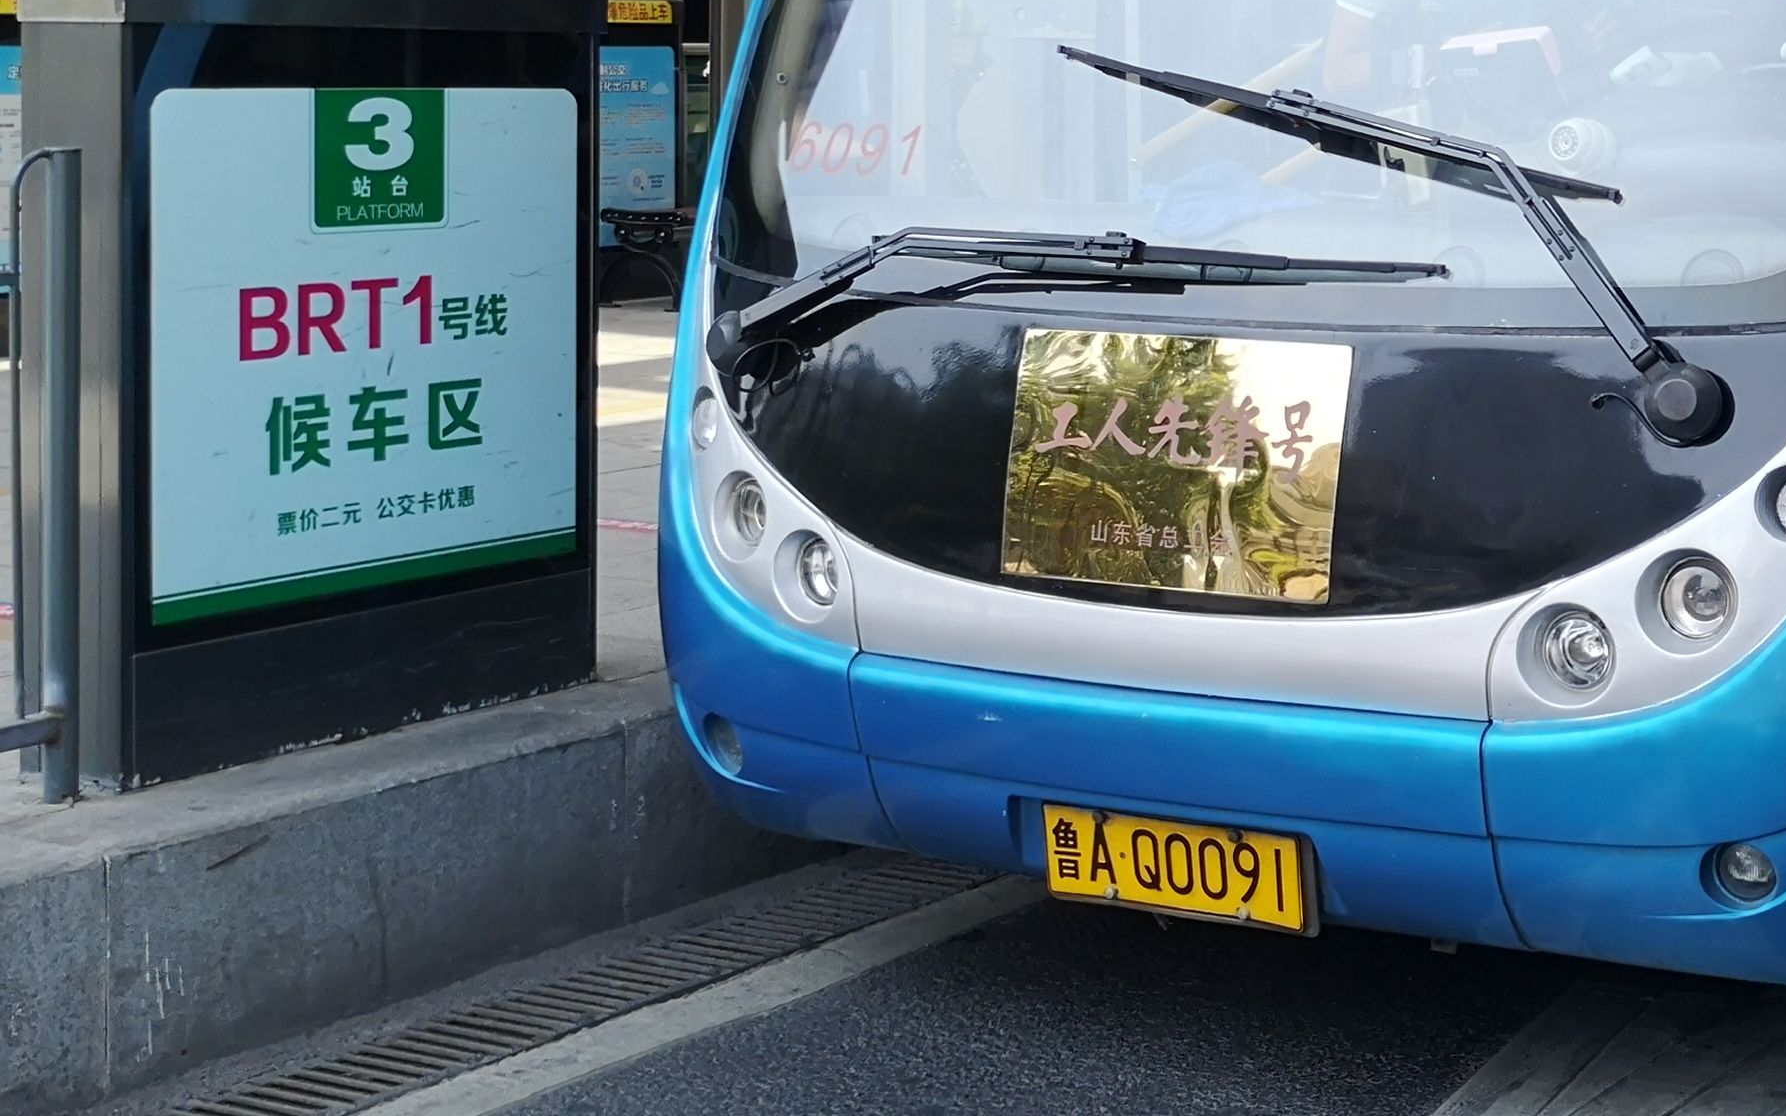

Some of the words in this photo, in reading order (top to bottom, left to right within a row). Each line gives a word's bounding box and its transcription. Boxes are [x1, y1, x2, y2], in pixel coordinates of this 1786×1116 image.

[344, 96, 415, 171] 3
[789, 121, 922, 177] 6091
[336, 202, 425, 222] PLATFORM
[265, 377, 484, 477] 候车区
[1035, 395, 1313, 485] 工人先锋号
[277, 501, 363, 536] 票价二元
[376, 485, 476, 520] 公交卡优惠
